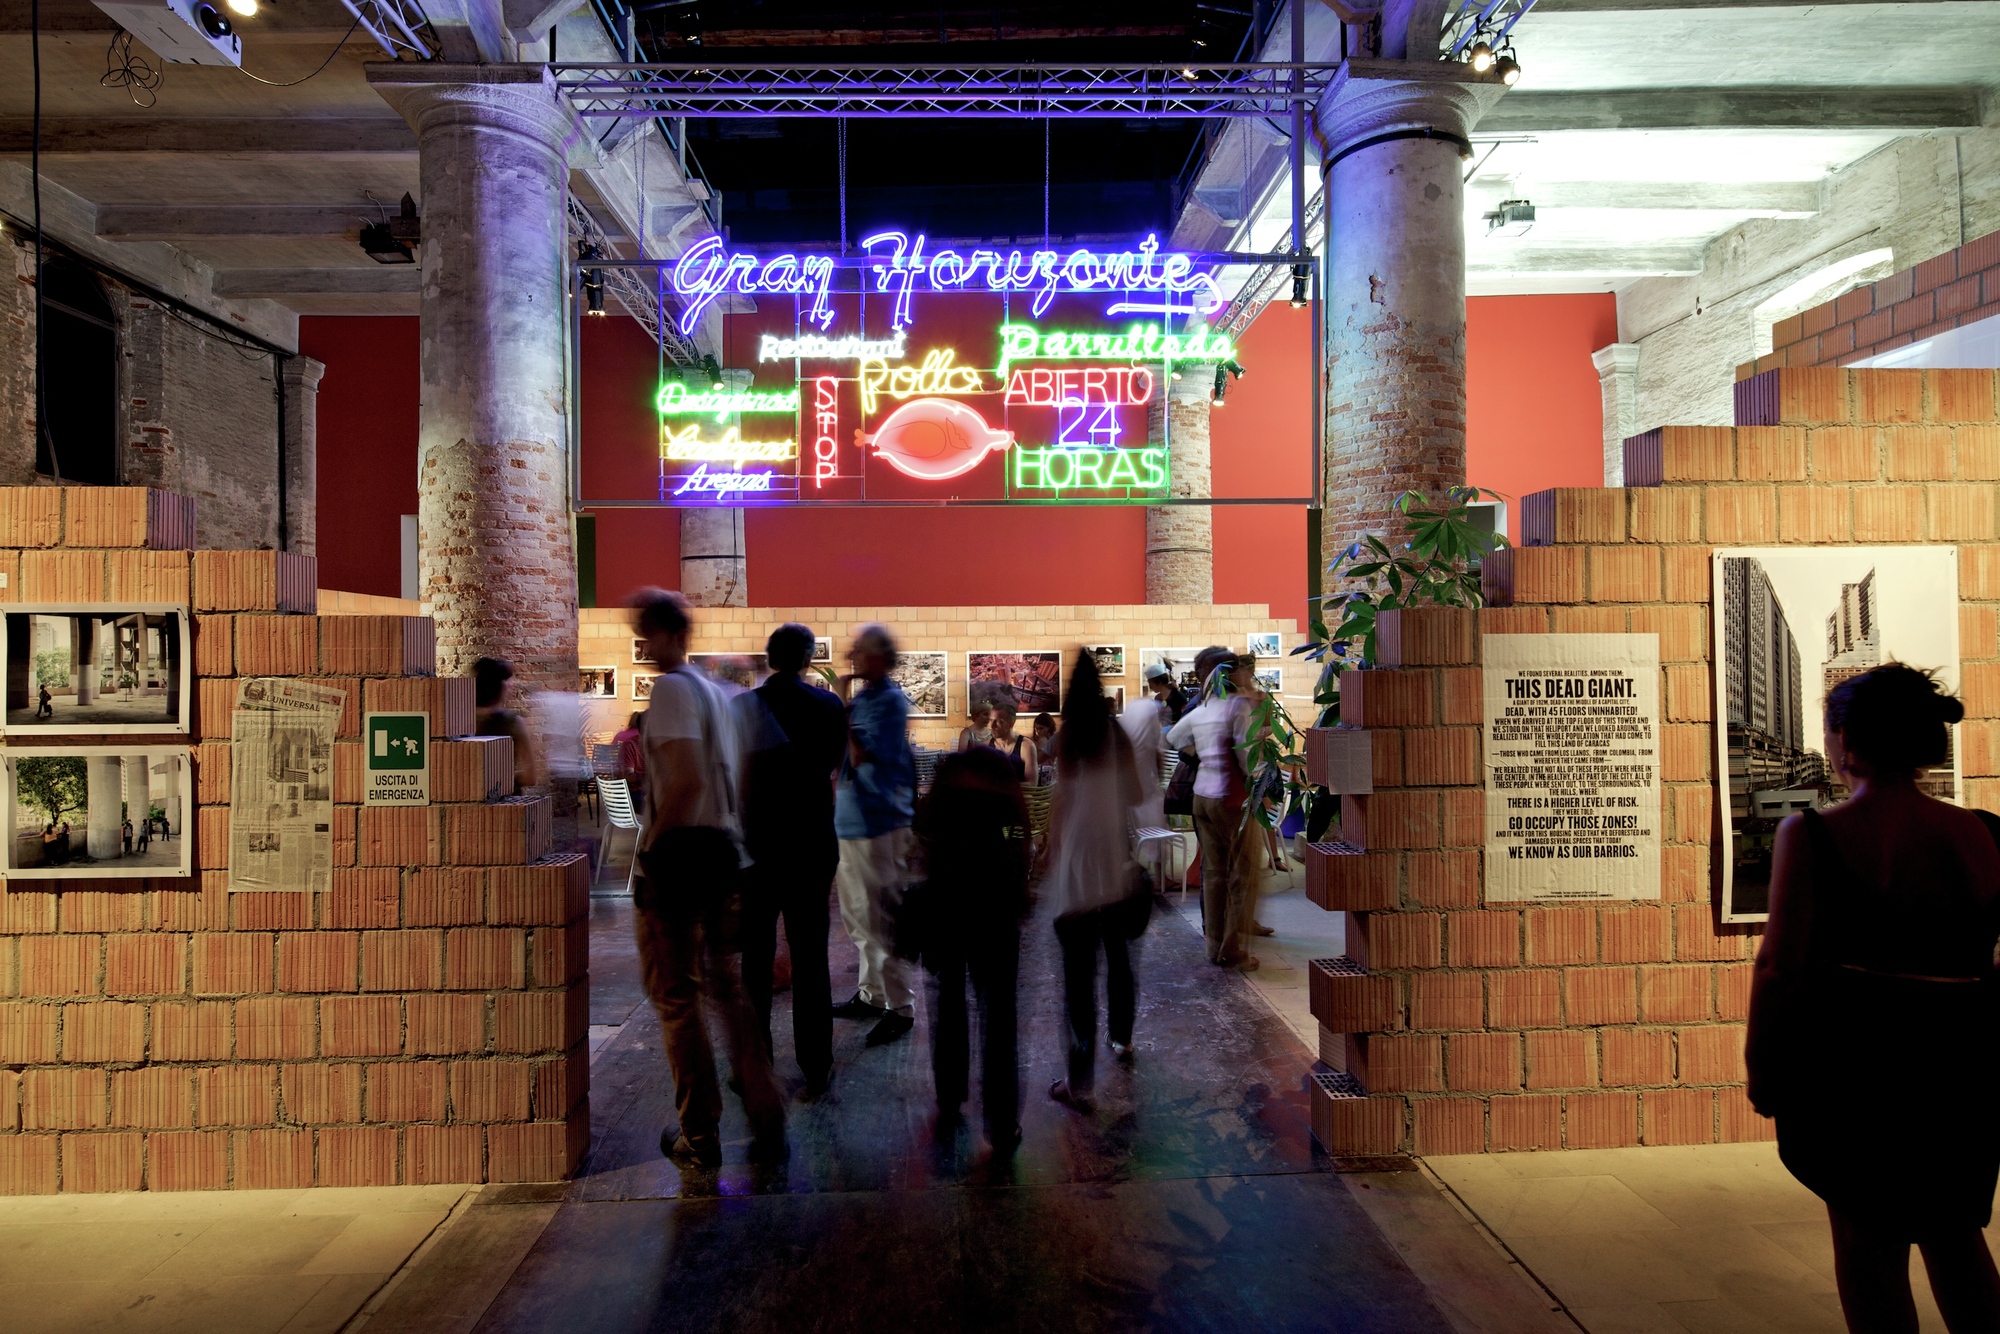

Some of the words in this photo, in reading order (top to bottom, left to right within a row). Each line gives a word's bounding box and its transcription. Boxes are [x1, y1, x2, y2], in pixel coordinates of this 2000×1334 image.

[674, 235, 836, 332] Gran
[862, 231, 1223, 331] Horizonte
[998, 322, 1238, 378] Parrillada
[860, 348, 982, 415] Pollo
[1004, 367, 1154, 405] ABIERTO
[1057, 397, 1122, 447] 24
[814, 375, 839, 489] STOP
[1015, 447, 1166, 488] HORAS
[673, 462, 773, 500] Arepas
[1505, 679, 1541, 699] THIS
[1545, 679, 1584, 698] DEAD
[1588, 679, 1637, 698] GIANT.
[272, 696, 320, 712] UNIVERSAL
[1505, 707, 1527, 717] DEAD,
[1528, 707, 1547, 717] WITH
[1549, 707, 1558, 717] 45
[1559, 707, 1587, 716] FLOORS
[1587, 707, 1638, 716] UNINHABITED!
[1577, 717, 1595, 725] FLOOR
[1492, 725, 1501, 733] WE
[1502, 725, 1521, 733] STOOD
[1522, 725, 1530, 733] ON
[1585, 724, 1594, 732] WE
[1594, 724, 1616, 732] LOOKED
[1643, 724, 1651, 732] WE
[1535, 740, 1547, 748] FILL
[1547, 740, 1561, 748] THIS
[1561, 740, 1576, 748] LAND
[375, 775, 407, 786] USCITA
[409, 775, 418, 786] DI
[1528, 773, 1535, 781] IN
[1535, 773, 1546, 781] THE
[1634, 772, 1645, 780] ALL
[1645, 772, 1653, 780] OF
[1495, 781, 1513, 789] THESE
[369, 789, 425, 800] EMERGENZA
[1579, 788, 1598, 796] WHERE
[1507, 798, 1532, 808] THERE
[1534, 798, 1542, 808] IS
[1544, 798, 1550, 808] A
[1550, 798, 1580, 808] HIGHER
[1582, 797, 1605, 808] LEVEL
[1606, 797, 1616, 808] OF
[1617, 797, 1640, 807] RISK.
[1509, 817, 1523, 830] GO
[1525, 816, 1565, 830] OCCUPY
[1567, 816, 1600, 829] THOSE
[1602, 816, 1638, 829] ZONES!
[1495, 830, 1507, 838] AND
[1507, 830, 1512, 838] IT
[1513, 830, 1524, 838] WAS
[1587, 829, 1600, 837] THAT
[1600, 829, 1609, 837] WE
[1609, 829, 1640, 837] DEFORESTED
[1572, 837, 1592, 845] SPACES
[1593, 837, 1605, 845] THAT
[1508, 846, 1523, 859] WE
[1525, 846, 1554, 859] KNOW
[1557, 846, 1570, 859] AS
[1572, 845, 1592, 859] OUR
[1594, 845, 1639, 858] BARRIOS.
